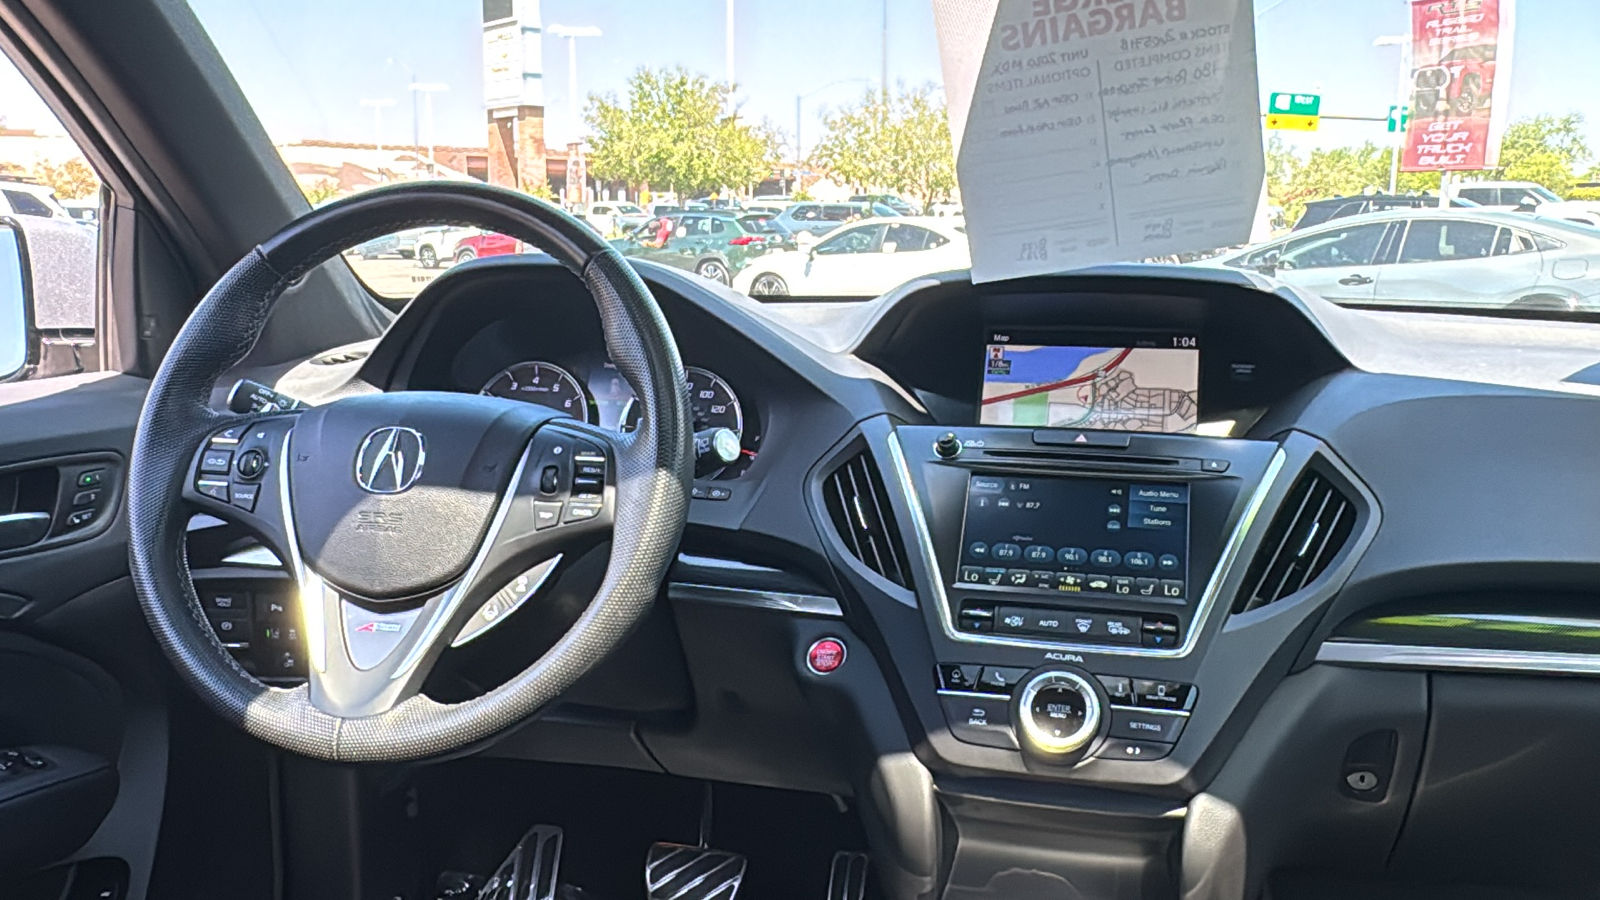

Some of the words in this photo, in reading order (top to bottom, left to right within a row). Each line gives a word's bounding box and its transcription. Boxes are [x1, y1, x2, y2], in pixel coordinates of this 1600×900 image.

[1428, 120, 1463, 132] GET
[1422, 131, 1469, 143] YOUR
[1416, 142, 1473, 154] TRUCK
[993, 334, 1010, 343] Map
[1173, 337, 1196, 347] 1:04
[510, 382, 518, 390] 3
[552, 383, 560, 392] 5
[700, 391, 714, 399] 100
[564, 400, 572, 408] 6
[711, 405, 726, 413] 120
[1138, 489, 1159, 497] Audio
[1160, 490, 1179, 498] Menu
[1143, 518, 1171, 526] Stations
[999, 549, 1014, 557] 87.9
[1044, 652, 1084, 662] ACURA
[1047, 703, 1072, 713] ENTER
[968, 718, 987, 726] BACK
[1129, 722, 1161, 731] SETTINGS
